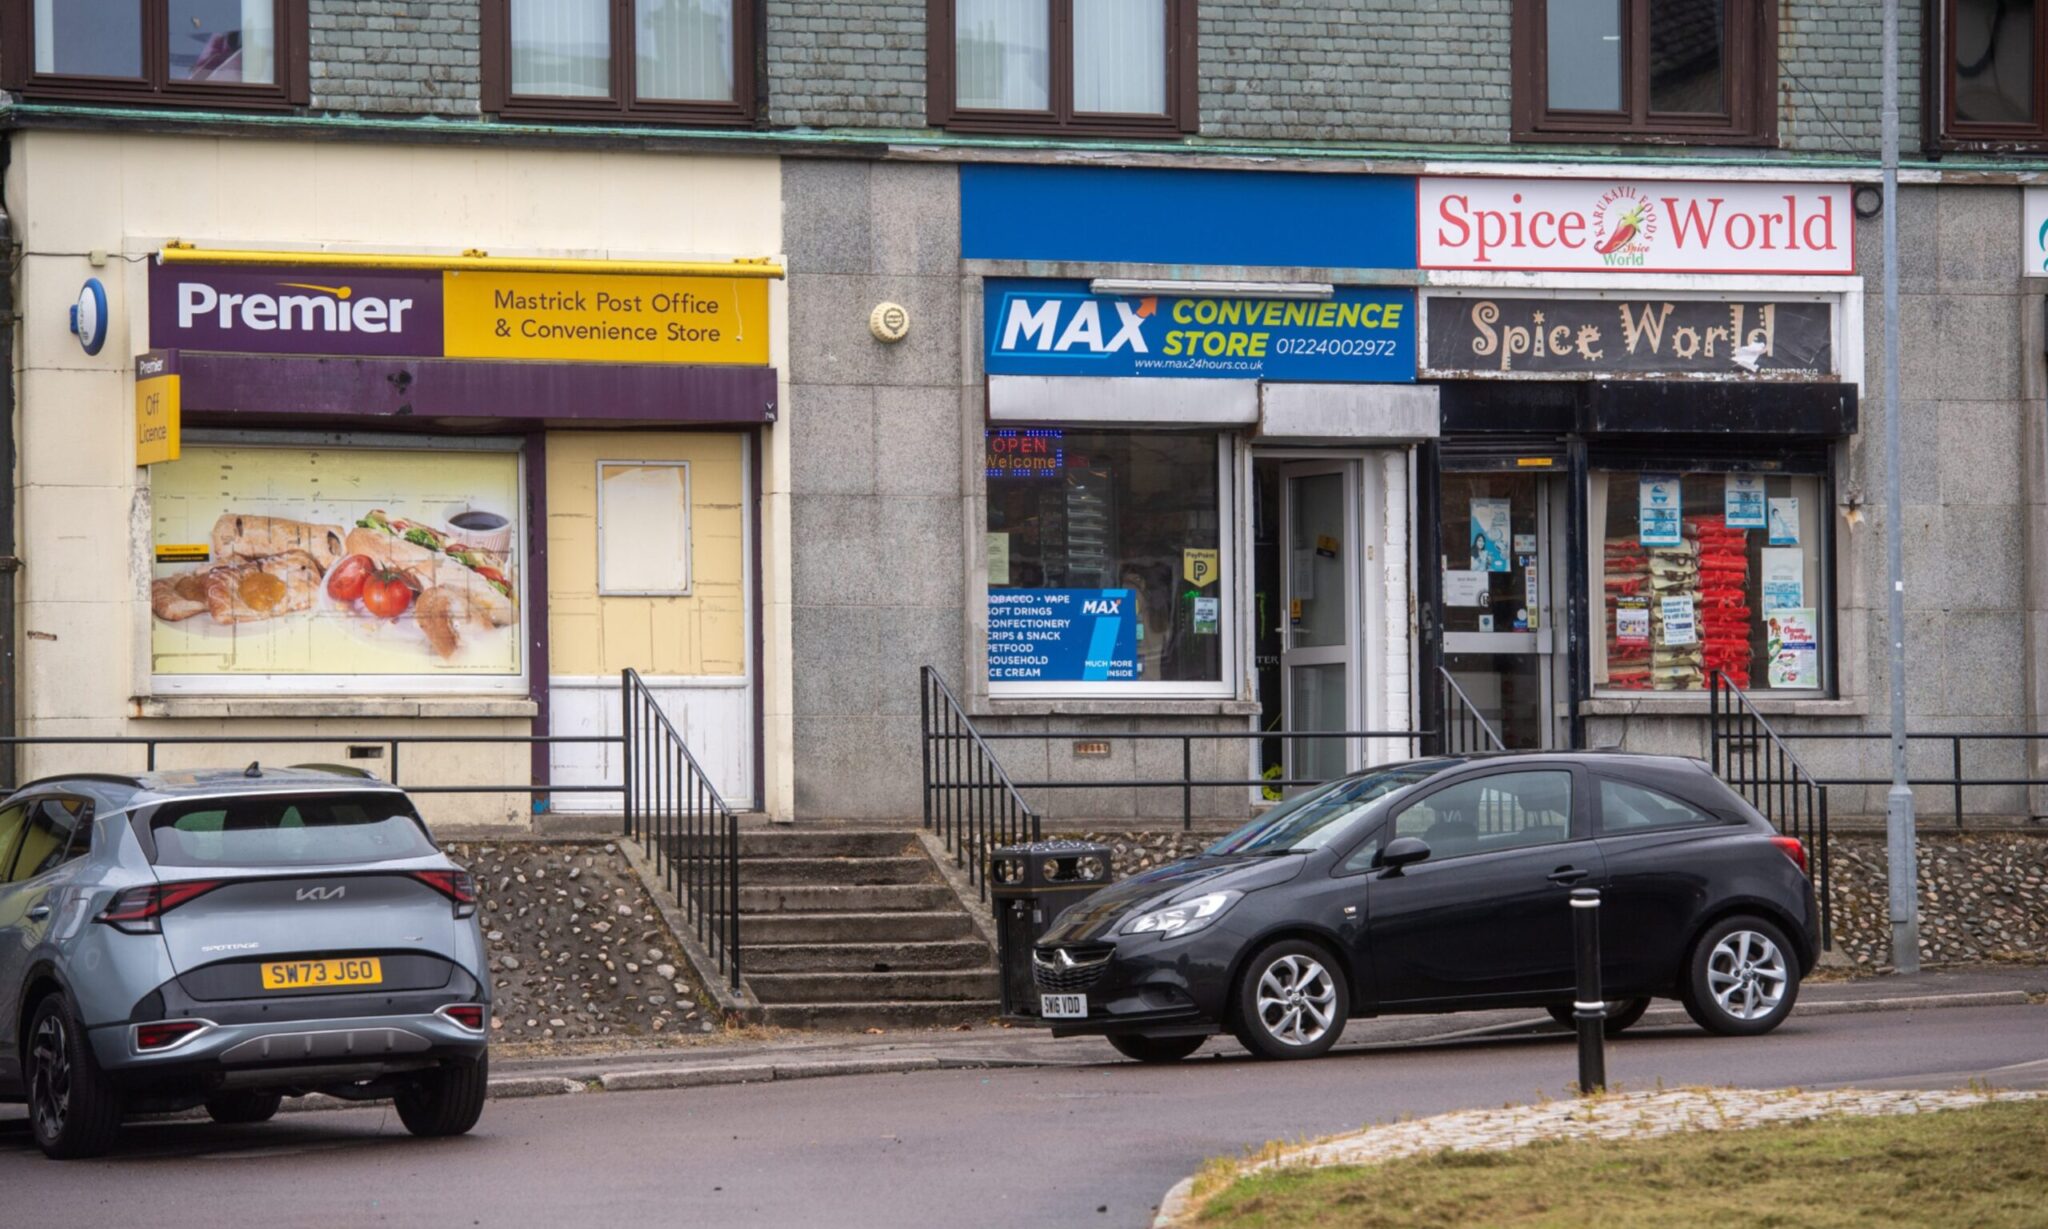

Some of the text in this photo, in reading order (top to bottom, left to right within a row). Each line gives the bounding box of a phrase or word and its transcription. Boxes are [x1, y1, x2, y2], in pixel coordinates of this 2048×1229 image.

[1593, 186, 1657, 242] KARUKAYIL FOODS
[1438, 193, 1837, 262] Spice World
[1621, 242, 1650, 255] Spice
[1602, 253, 1644, 266] World
[178, 282, 413, 333] Premier
[494, 289, 719, 314] Mastrick Post Office
[1172, 298, 1403, 329] CONVENIENCE
[495, 318, 721, 342] & Convenience Store
[1001, 299, 1149, 353] MAX
[1163, 330, 1396, 357] STORE 01224002972
[1472, 301, 1775, 371] Spice World
[139, 358, 164, 375] Premier
[1134, 358, 1264, 371] www.max24hours.co.uk
[146, 392, 160, 416] Off
[139, 423, 167, 444] Licence
[992, 438, 1047, 453] OPEN
[986, 454, 1056, 468] Welcome
[1044, 594, 1070, 604] VAPE
[1082, 600, 1120, 614] MAX
[1013, 607, 1052, 616] DRINGS
[1017, 631, 1024, 640] &
[1026, 631, 1061, 640] SNACK
[987, 643, 1034, 653] PETFOOD
[1004, 668, 1041, 677] CREAM
[1106, 669, 1133, 677] INSIDE
[296, 886, 346, 901] KIA
[272, 960, 373, 984] SW73 JGO
[1044, 996, 1080, 1013] SW16 VDD
